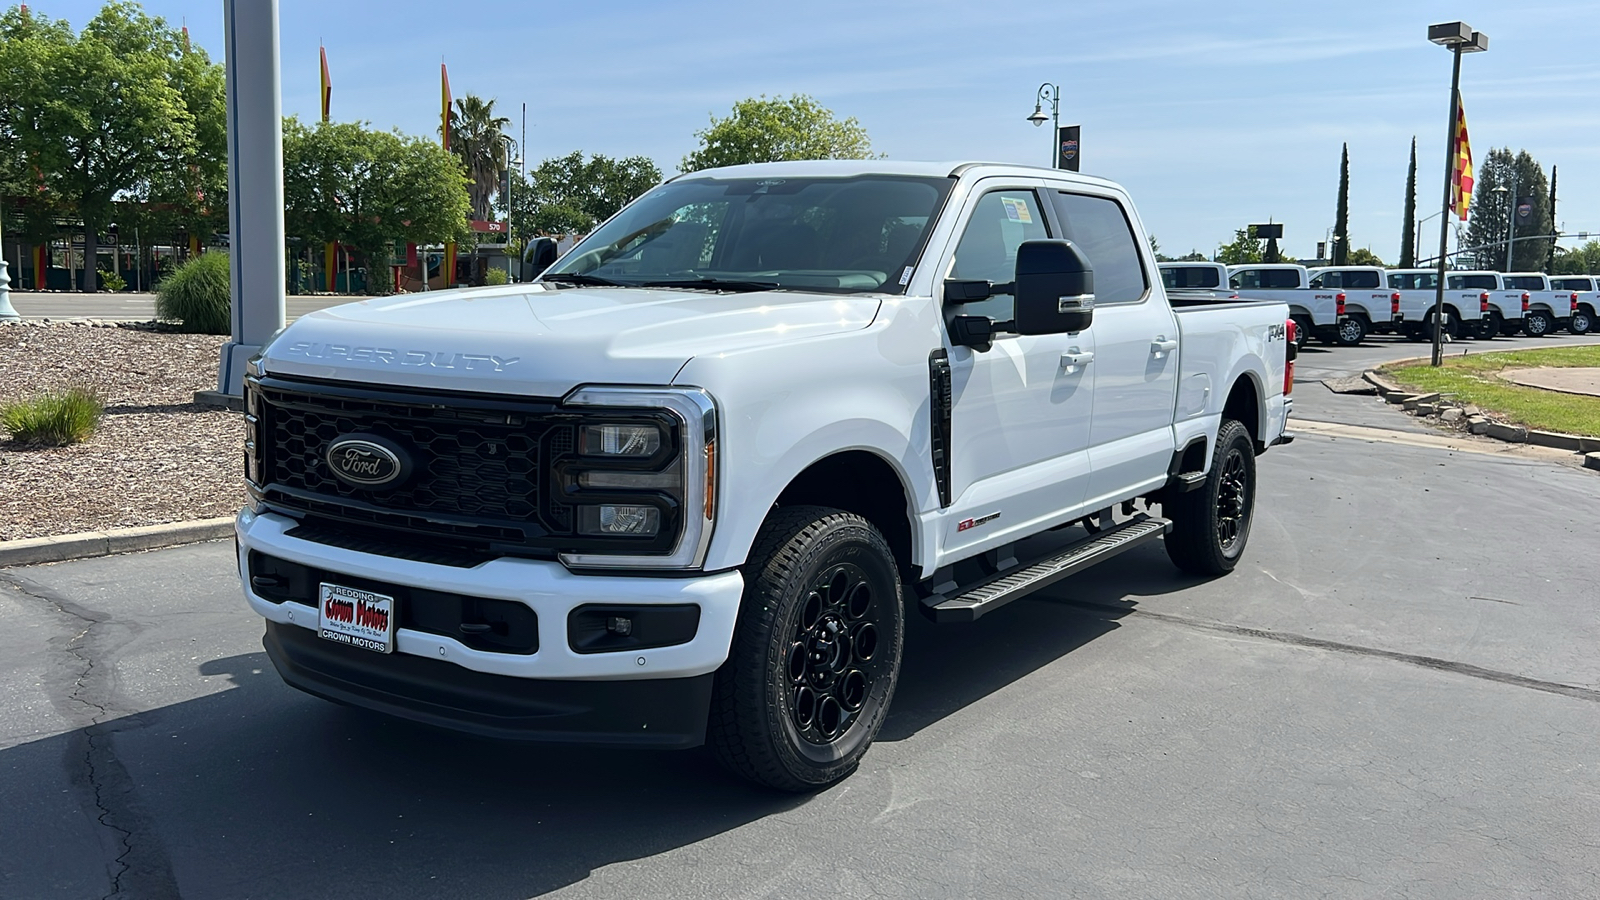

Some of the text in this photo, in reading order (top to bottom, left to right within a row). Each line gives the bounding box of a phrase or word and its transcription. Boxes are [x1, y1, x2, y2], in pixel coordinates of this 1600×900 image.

[489, 223, 501, 231] 570
[289, 341, 520, 372] SUPER DUTY
[342, 448, 381, 476] Ford
[336, 587, 374, 602] REDDING
[325, 594, 389, 633] Crown Motors
[322, 629, 385, 652] CROWN MOTORS
